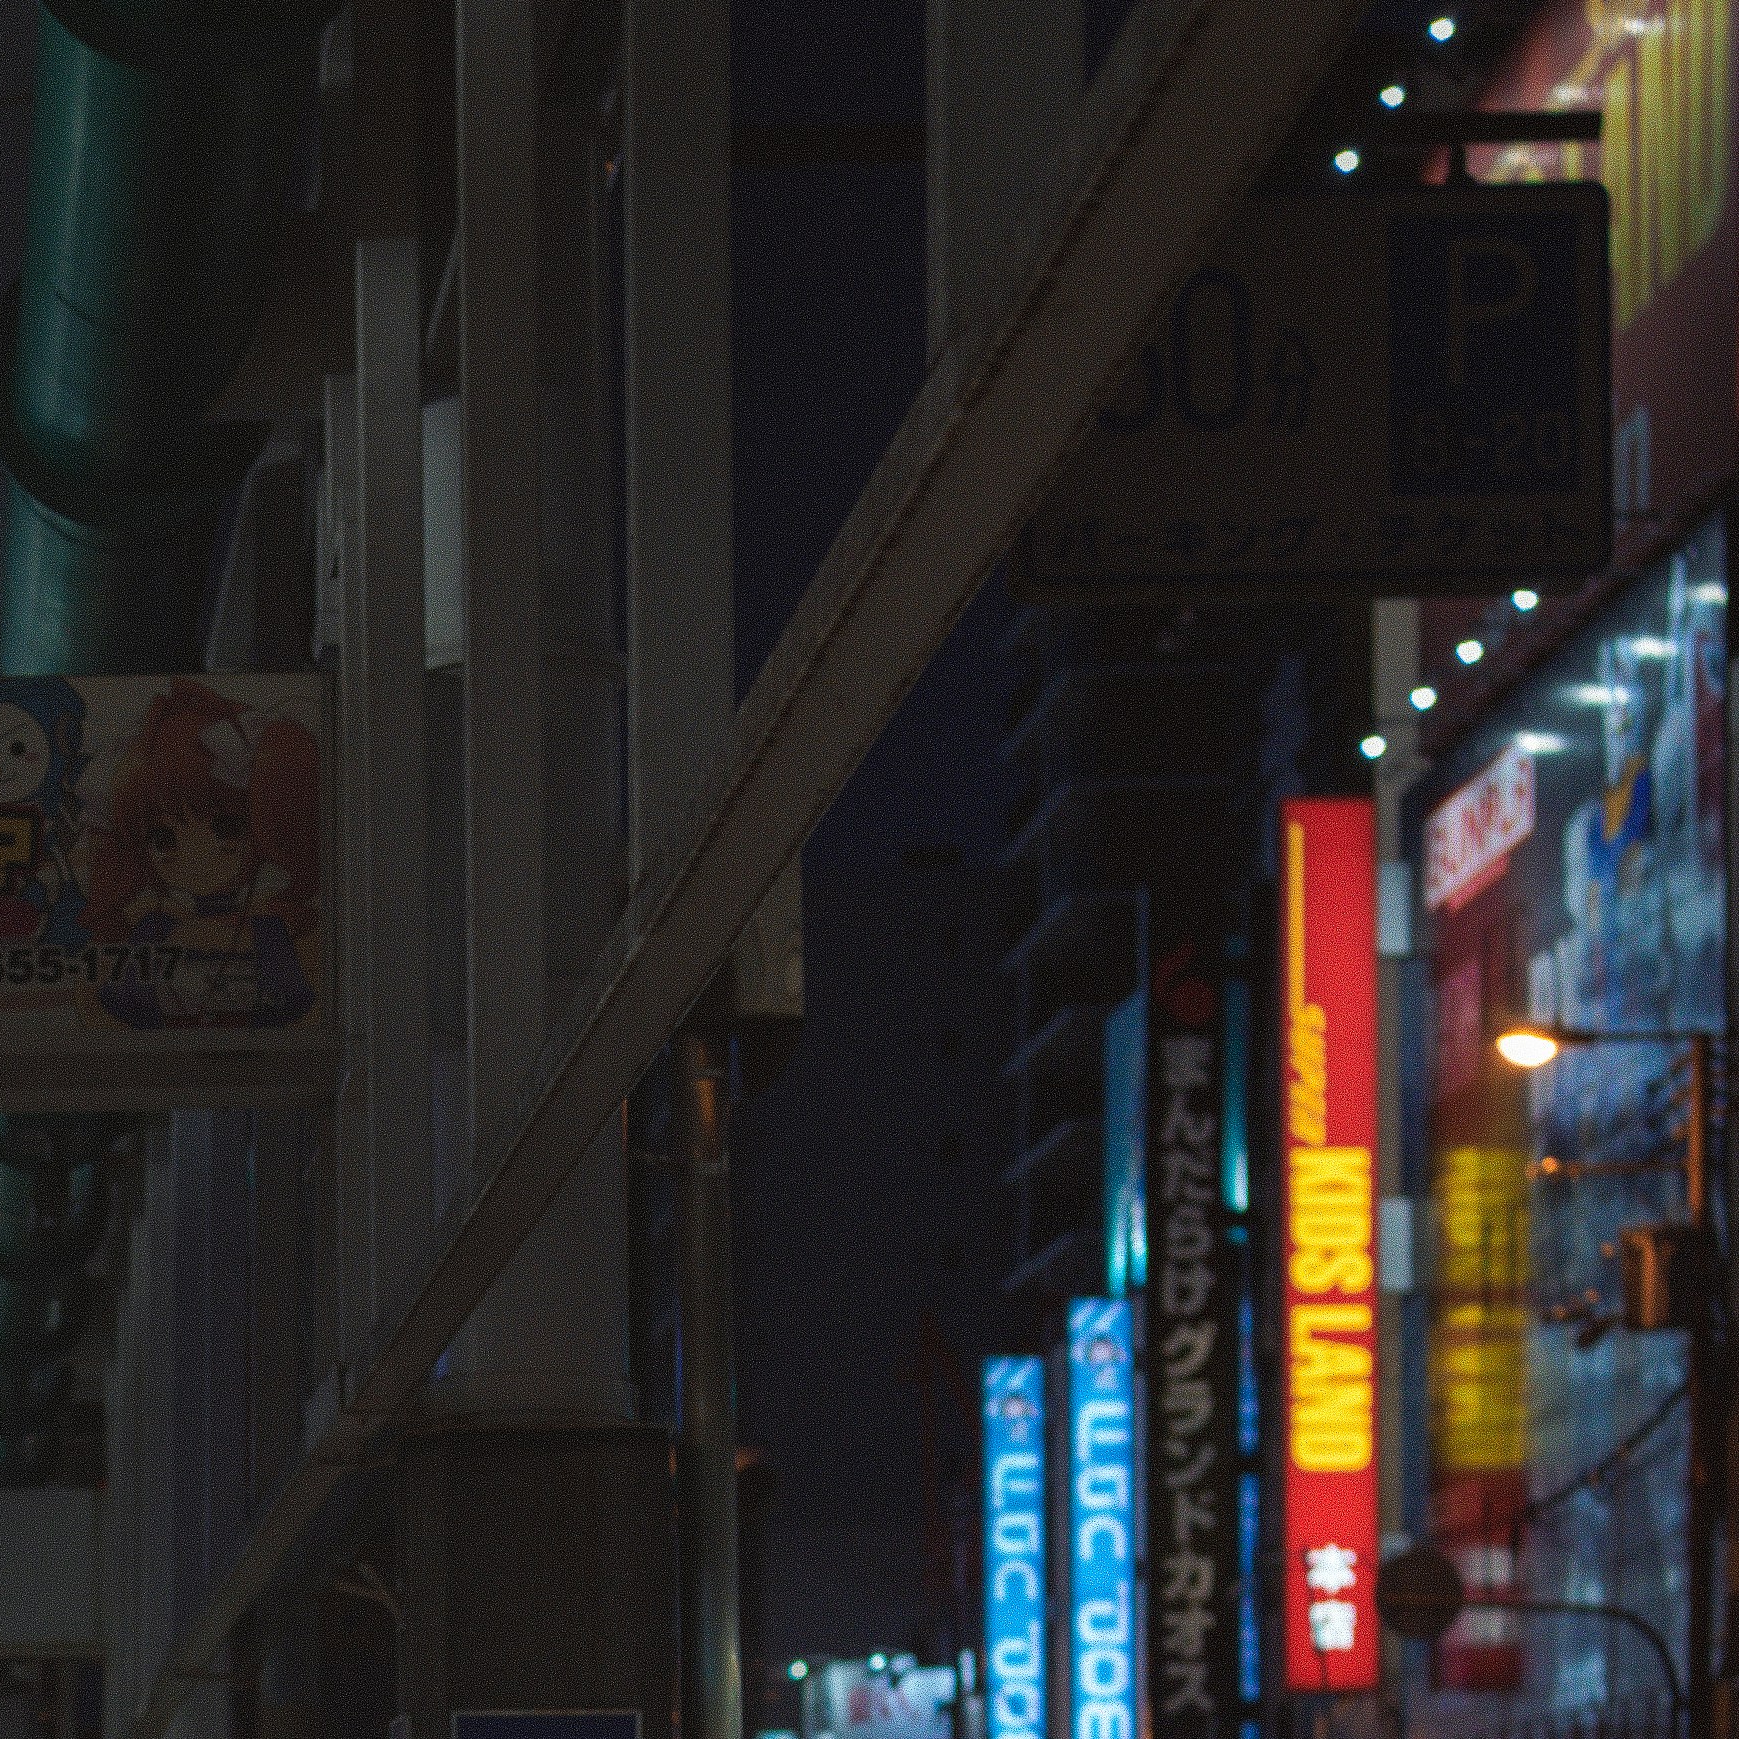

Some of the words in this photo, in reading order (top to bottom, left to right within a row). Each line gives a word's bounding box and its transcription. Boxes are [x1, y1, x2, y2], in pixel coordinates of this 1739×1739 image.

[1445, 234, 1540, 393] P
[1289, 1143, 1373, 1296] KIDS
[1289, 1302, 1373, 1473] LAND
